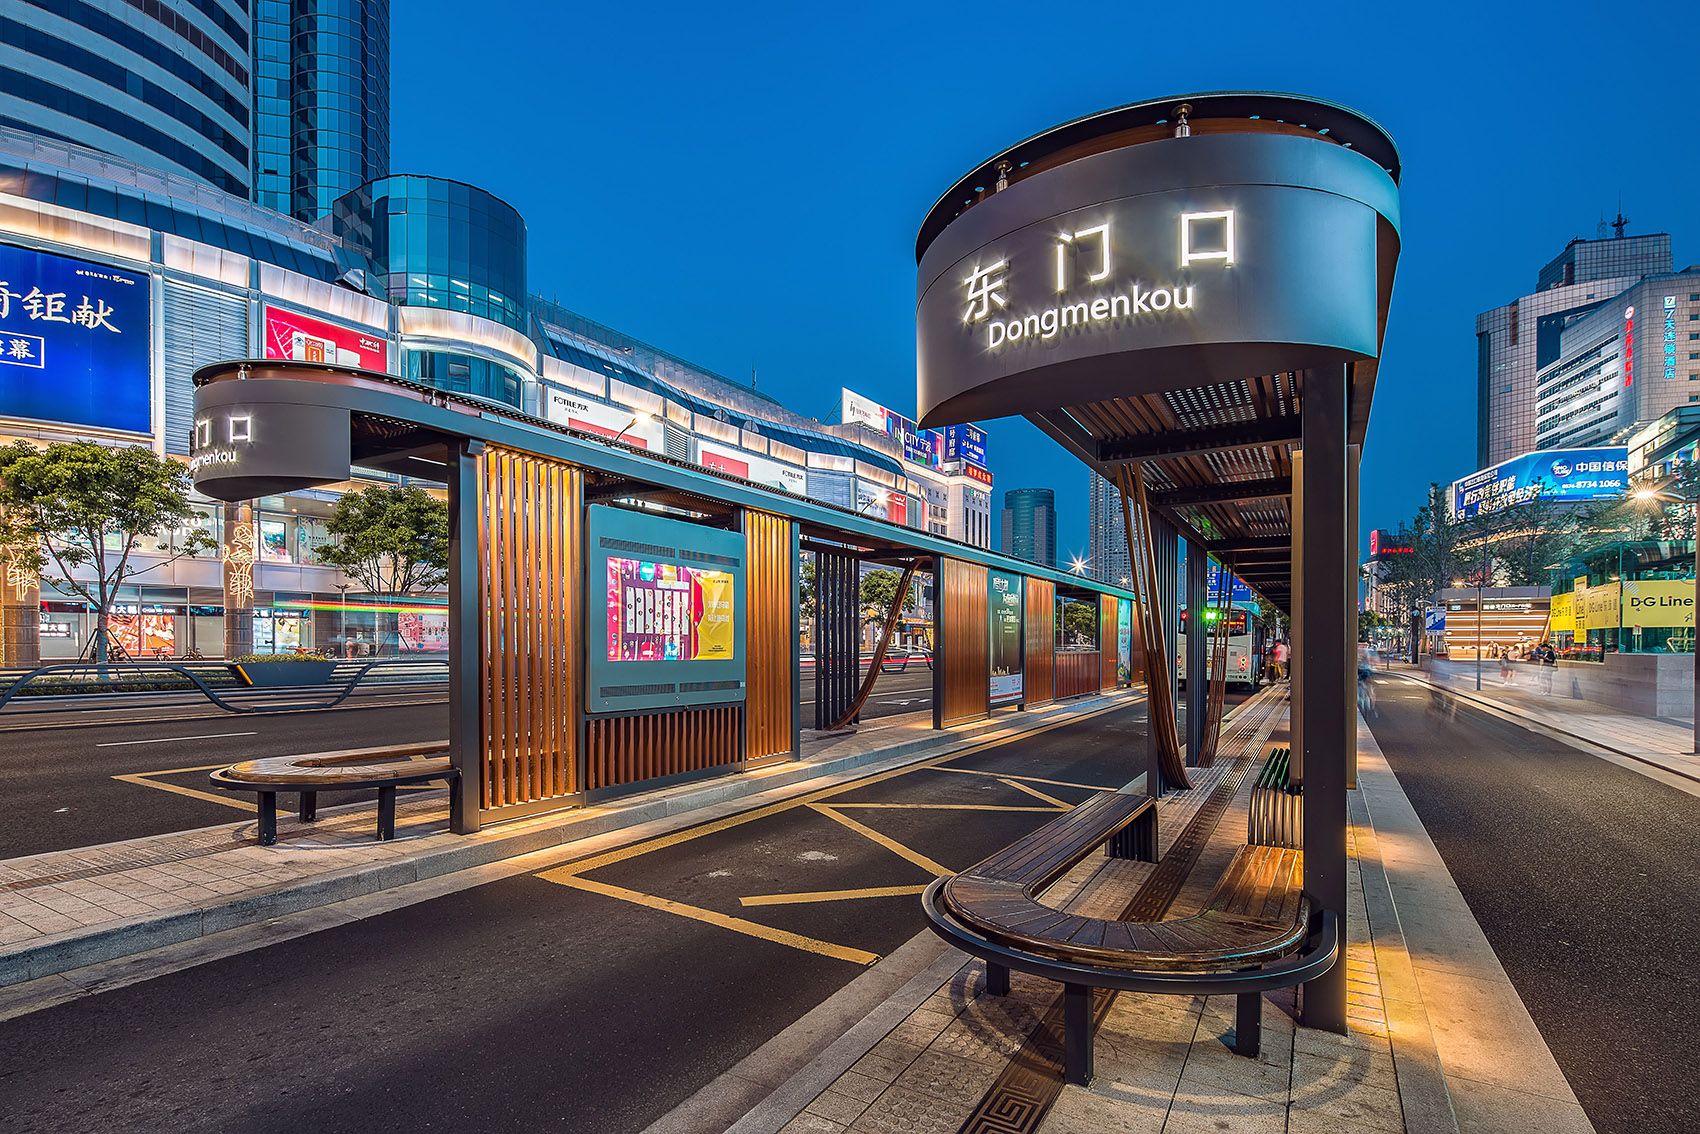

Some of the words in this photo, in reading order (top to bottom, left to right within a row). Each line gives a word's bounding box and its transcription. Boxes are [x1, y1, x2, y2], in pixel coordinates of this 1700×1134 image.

[962, 210, 1235, 328] 东门口
[988, 284, 1195, 349] Dongmenkou
[1599, 479, 1621, 488] 1066
[1660, 595, 1694, 607] Line
